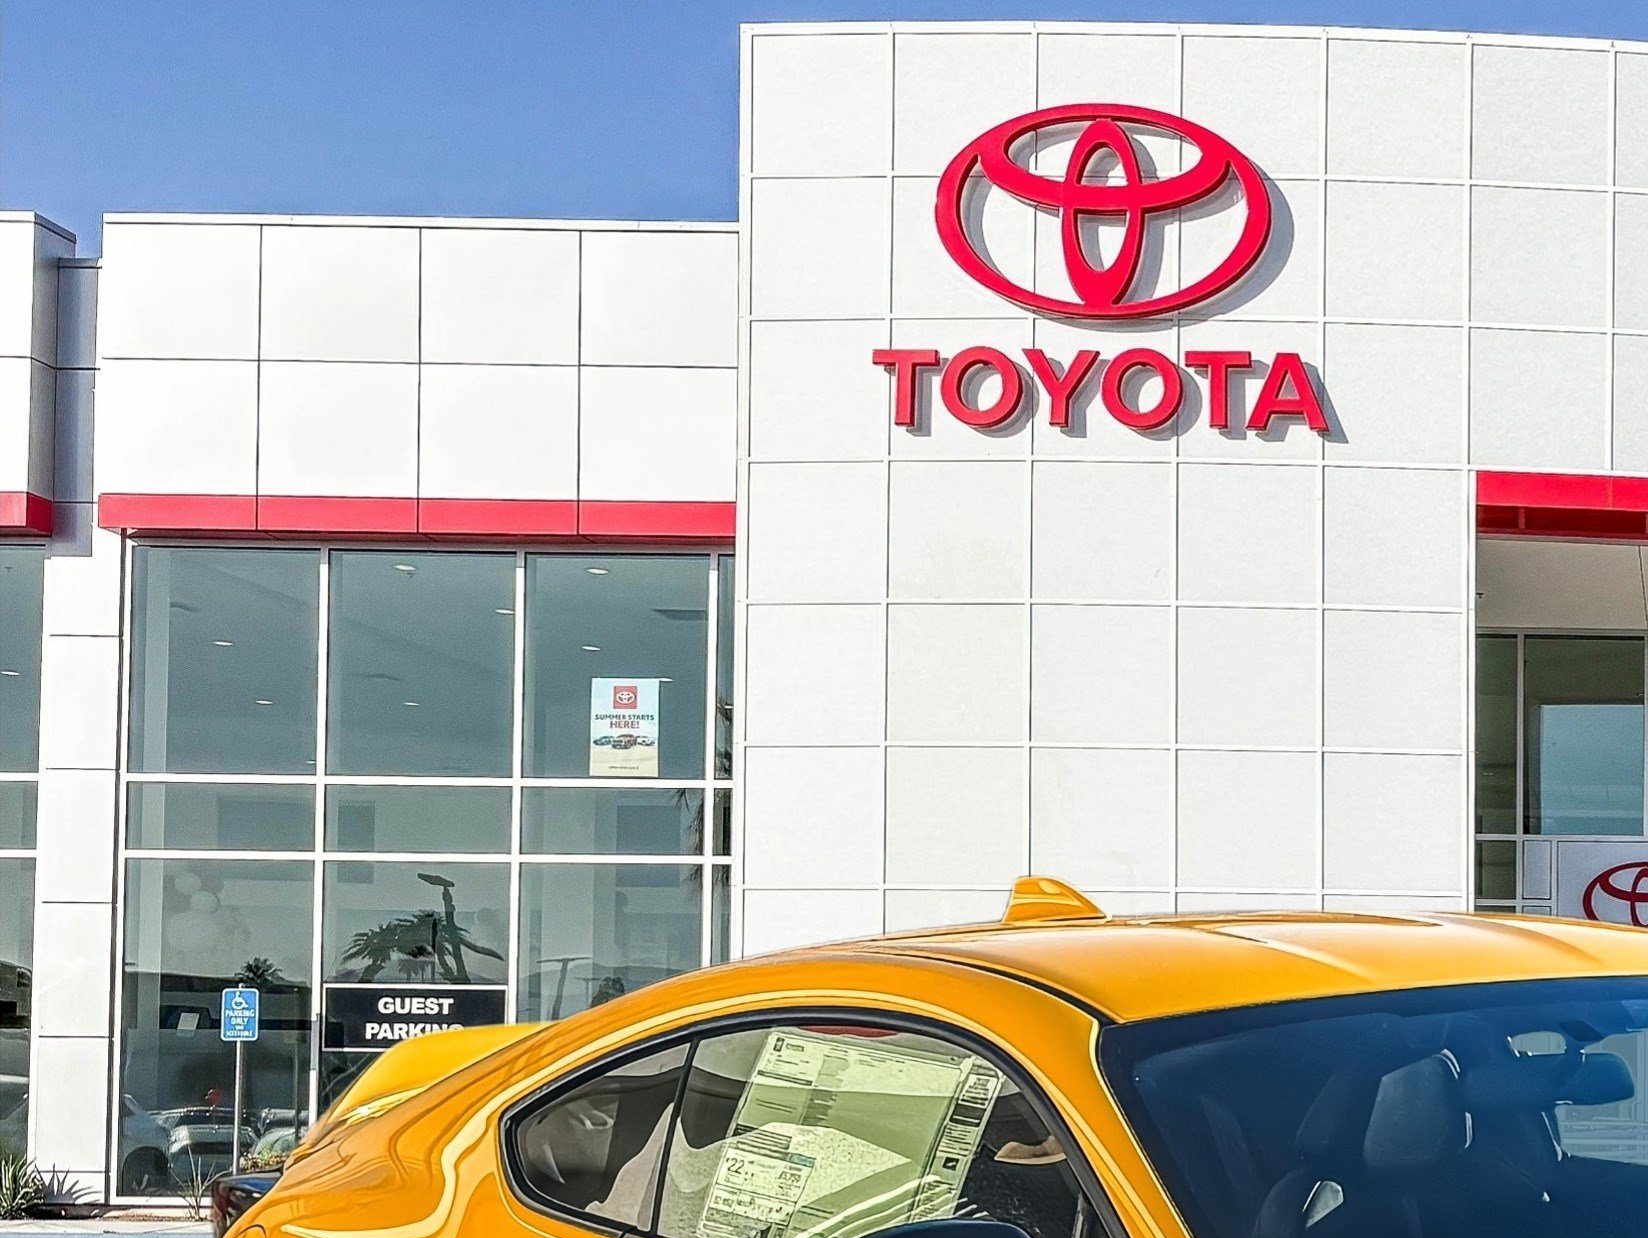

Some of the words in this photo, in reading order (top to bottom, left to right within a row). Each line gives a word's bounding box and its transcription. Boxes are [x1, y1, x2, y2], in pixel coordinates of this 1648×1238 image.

[872, 345, 1330, 434] TOYOTA
[609, 720, 640, 729] HERE!
[377, 997, 454, 1015] GUEST
